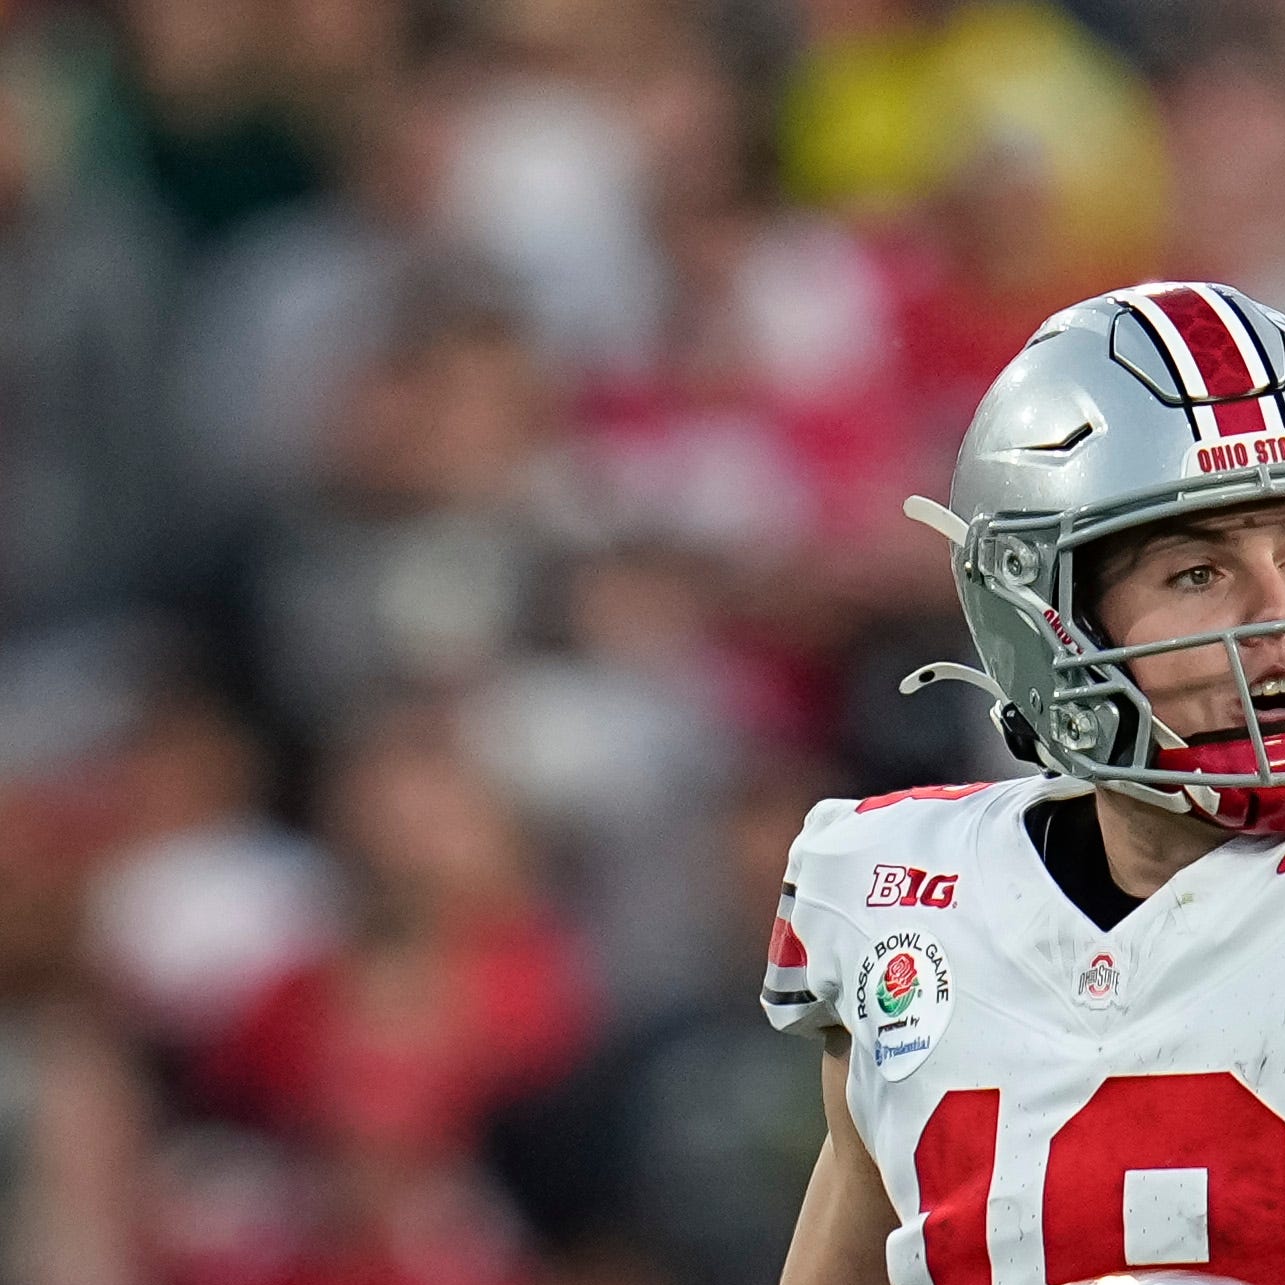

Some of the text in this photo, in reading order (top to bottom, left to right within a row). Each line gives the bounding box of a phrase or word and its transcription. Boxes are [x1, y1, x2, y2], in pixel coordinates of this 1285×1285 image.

[1196, 442, 1249, 474] OHIO
[856, 932, 949, 1020] ROSE BOWL GAME
